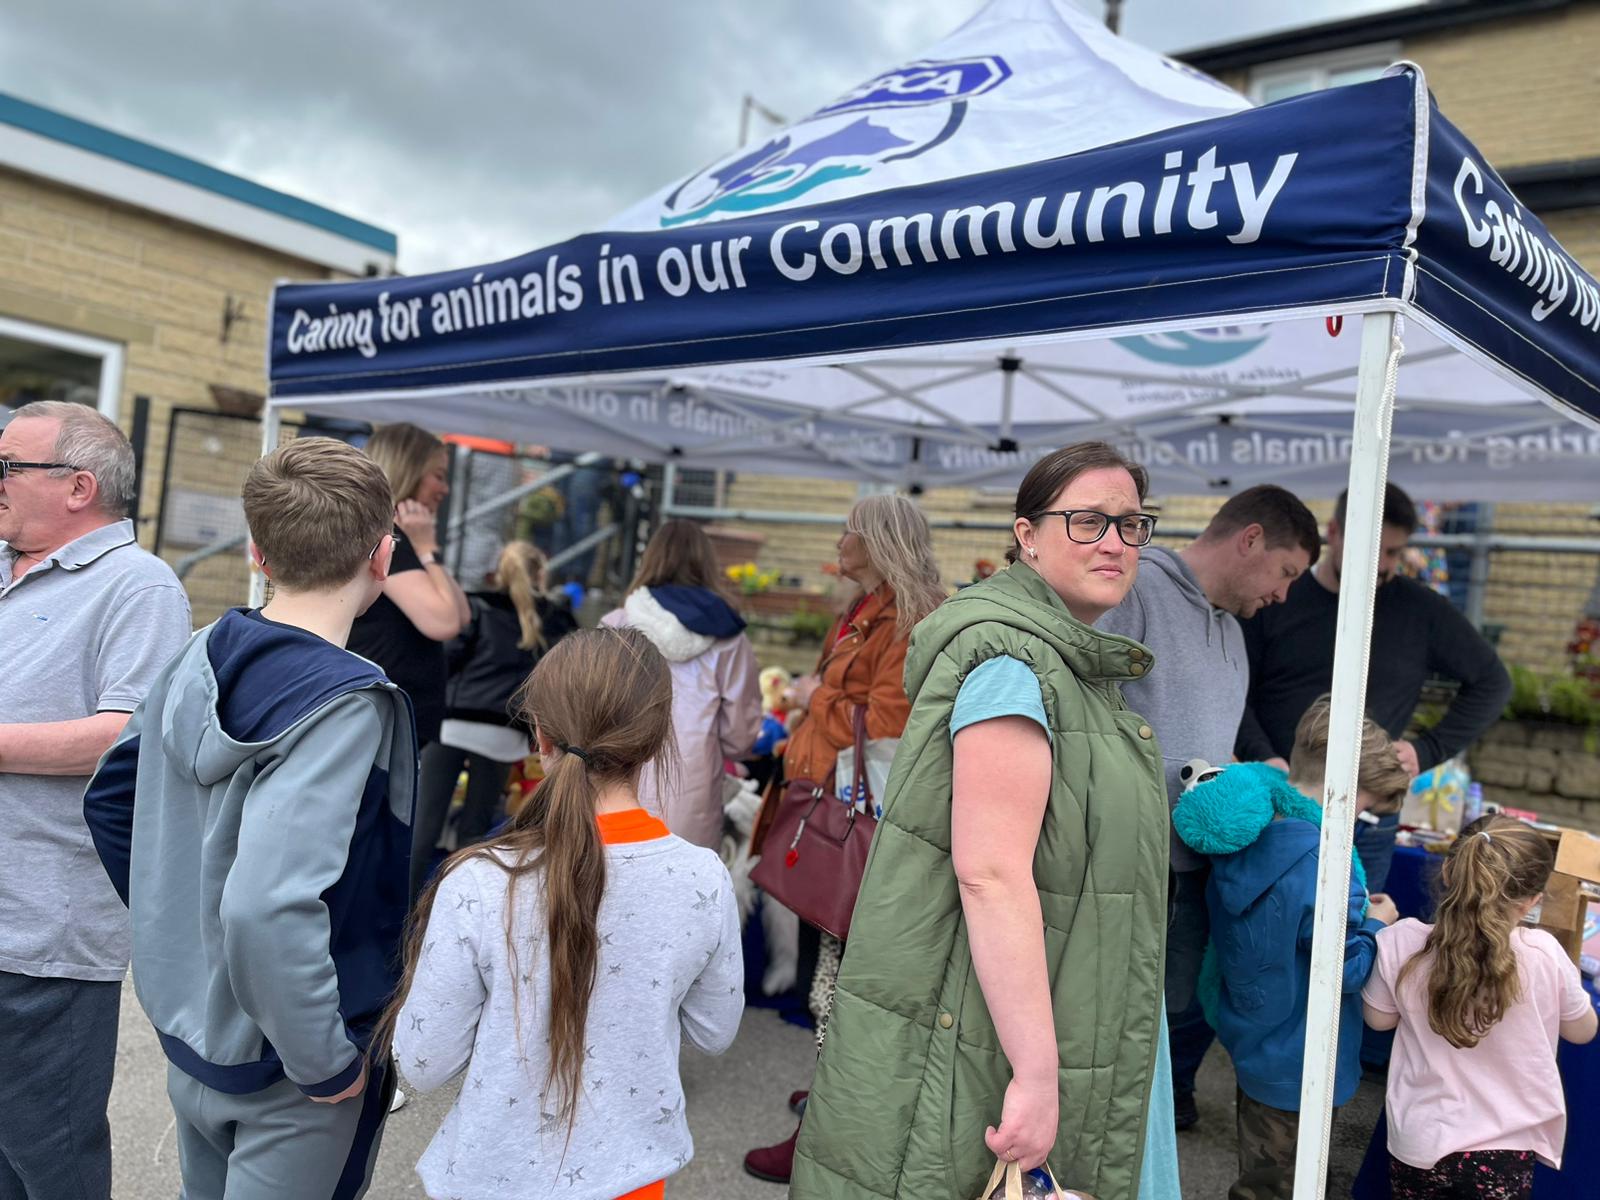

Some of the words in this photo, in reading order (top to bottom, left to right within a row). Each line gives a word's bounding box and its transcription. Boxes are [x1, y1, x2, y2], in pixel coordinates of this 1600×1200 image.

[287, 302, 377, 357] Caring
[378, 291, 422, 342] for
[431, 255, 583, 334] animals
[599, 243, 644, 304] in
[657, 235, 752, 293] our
[769, 146, 1298, 282] Community
[1454, 156, 1568, 322] Caring
